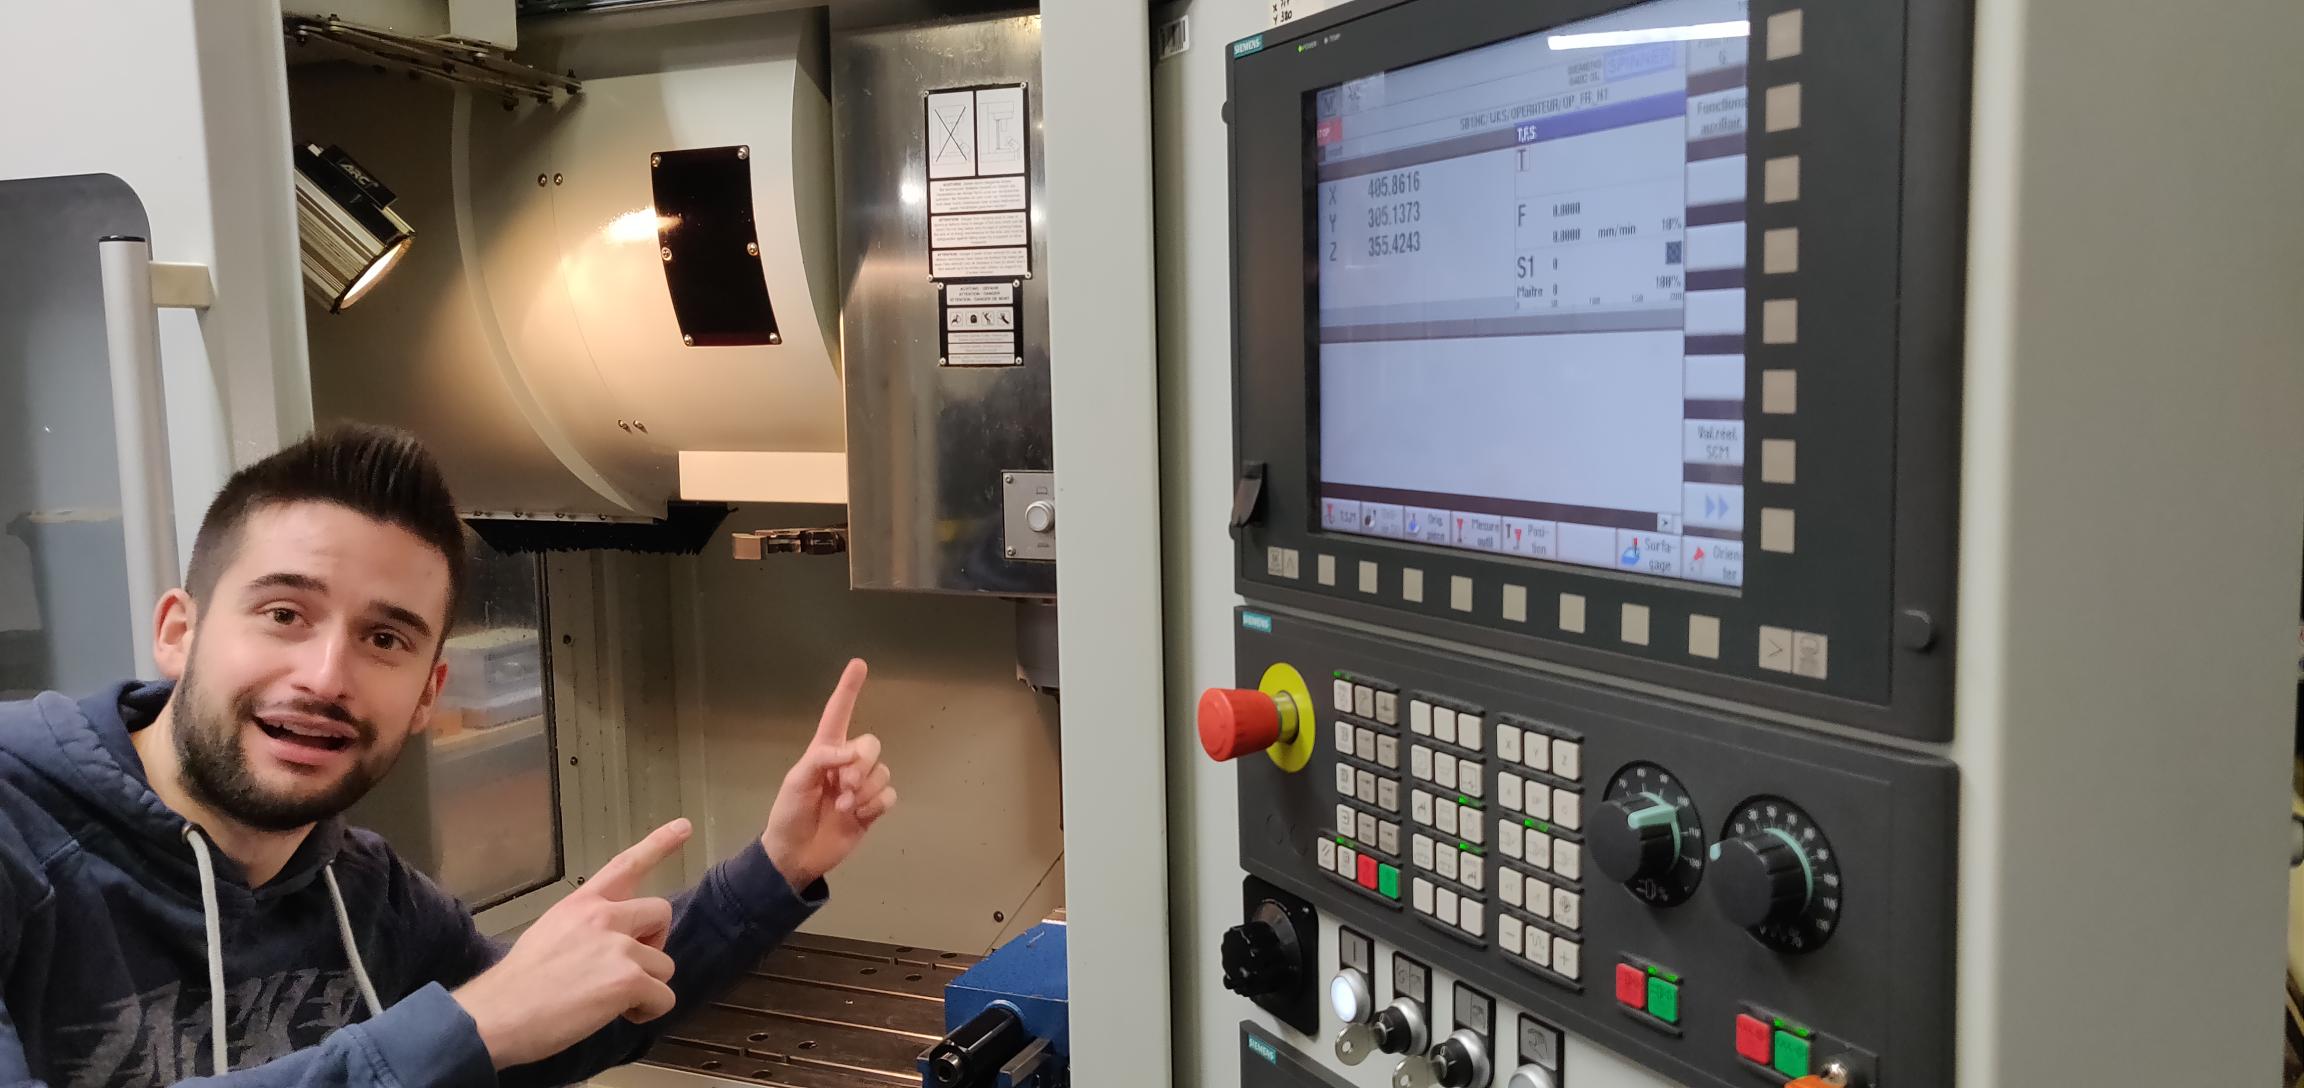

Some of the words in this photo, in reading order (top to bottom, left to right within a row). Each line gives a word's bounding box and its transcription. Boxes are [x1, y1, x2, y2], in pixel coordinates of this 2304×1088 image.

[1273, 14, 1278, 25] Y
[1280, 10, 1293, 22] 380
[1234, 38, 1260, 56] SIEMENS
[1517, 149, 1527, 171] T
[1329, 186, 1337, 205] X
[1368, 171, 1421, 198] 405.8616
[1329, 214, 1337, 232] Y
[1368, 201, 1421, 228] 305.1373
[1518, 204, 1527, 227] F
[1598, 223, 1637, 239] mm/min
[1329, 242, 1337, 261] Z
[1368, 231, 1421, 256] 355.4243
[1517, 256, 1534, 279] S1
[1248, 1037, 1275, 1062] SIEMENS
